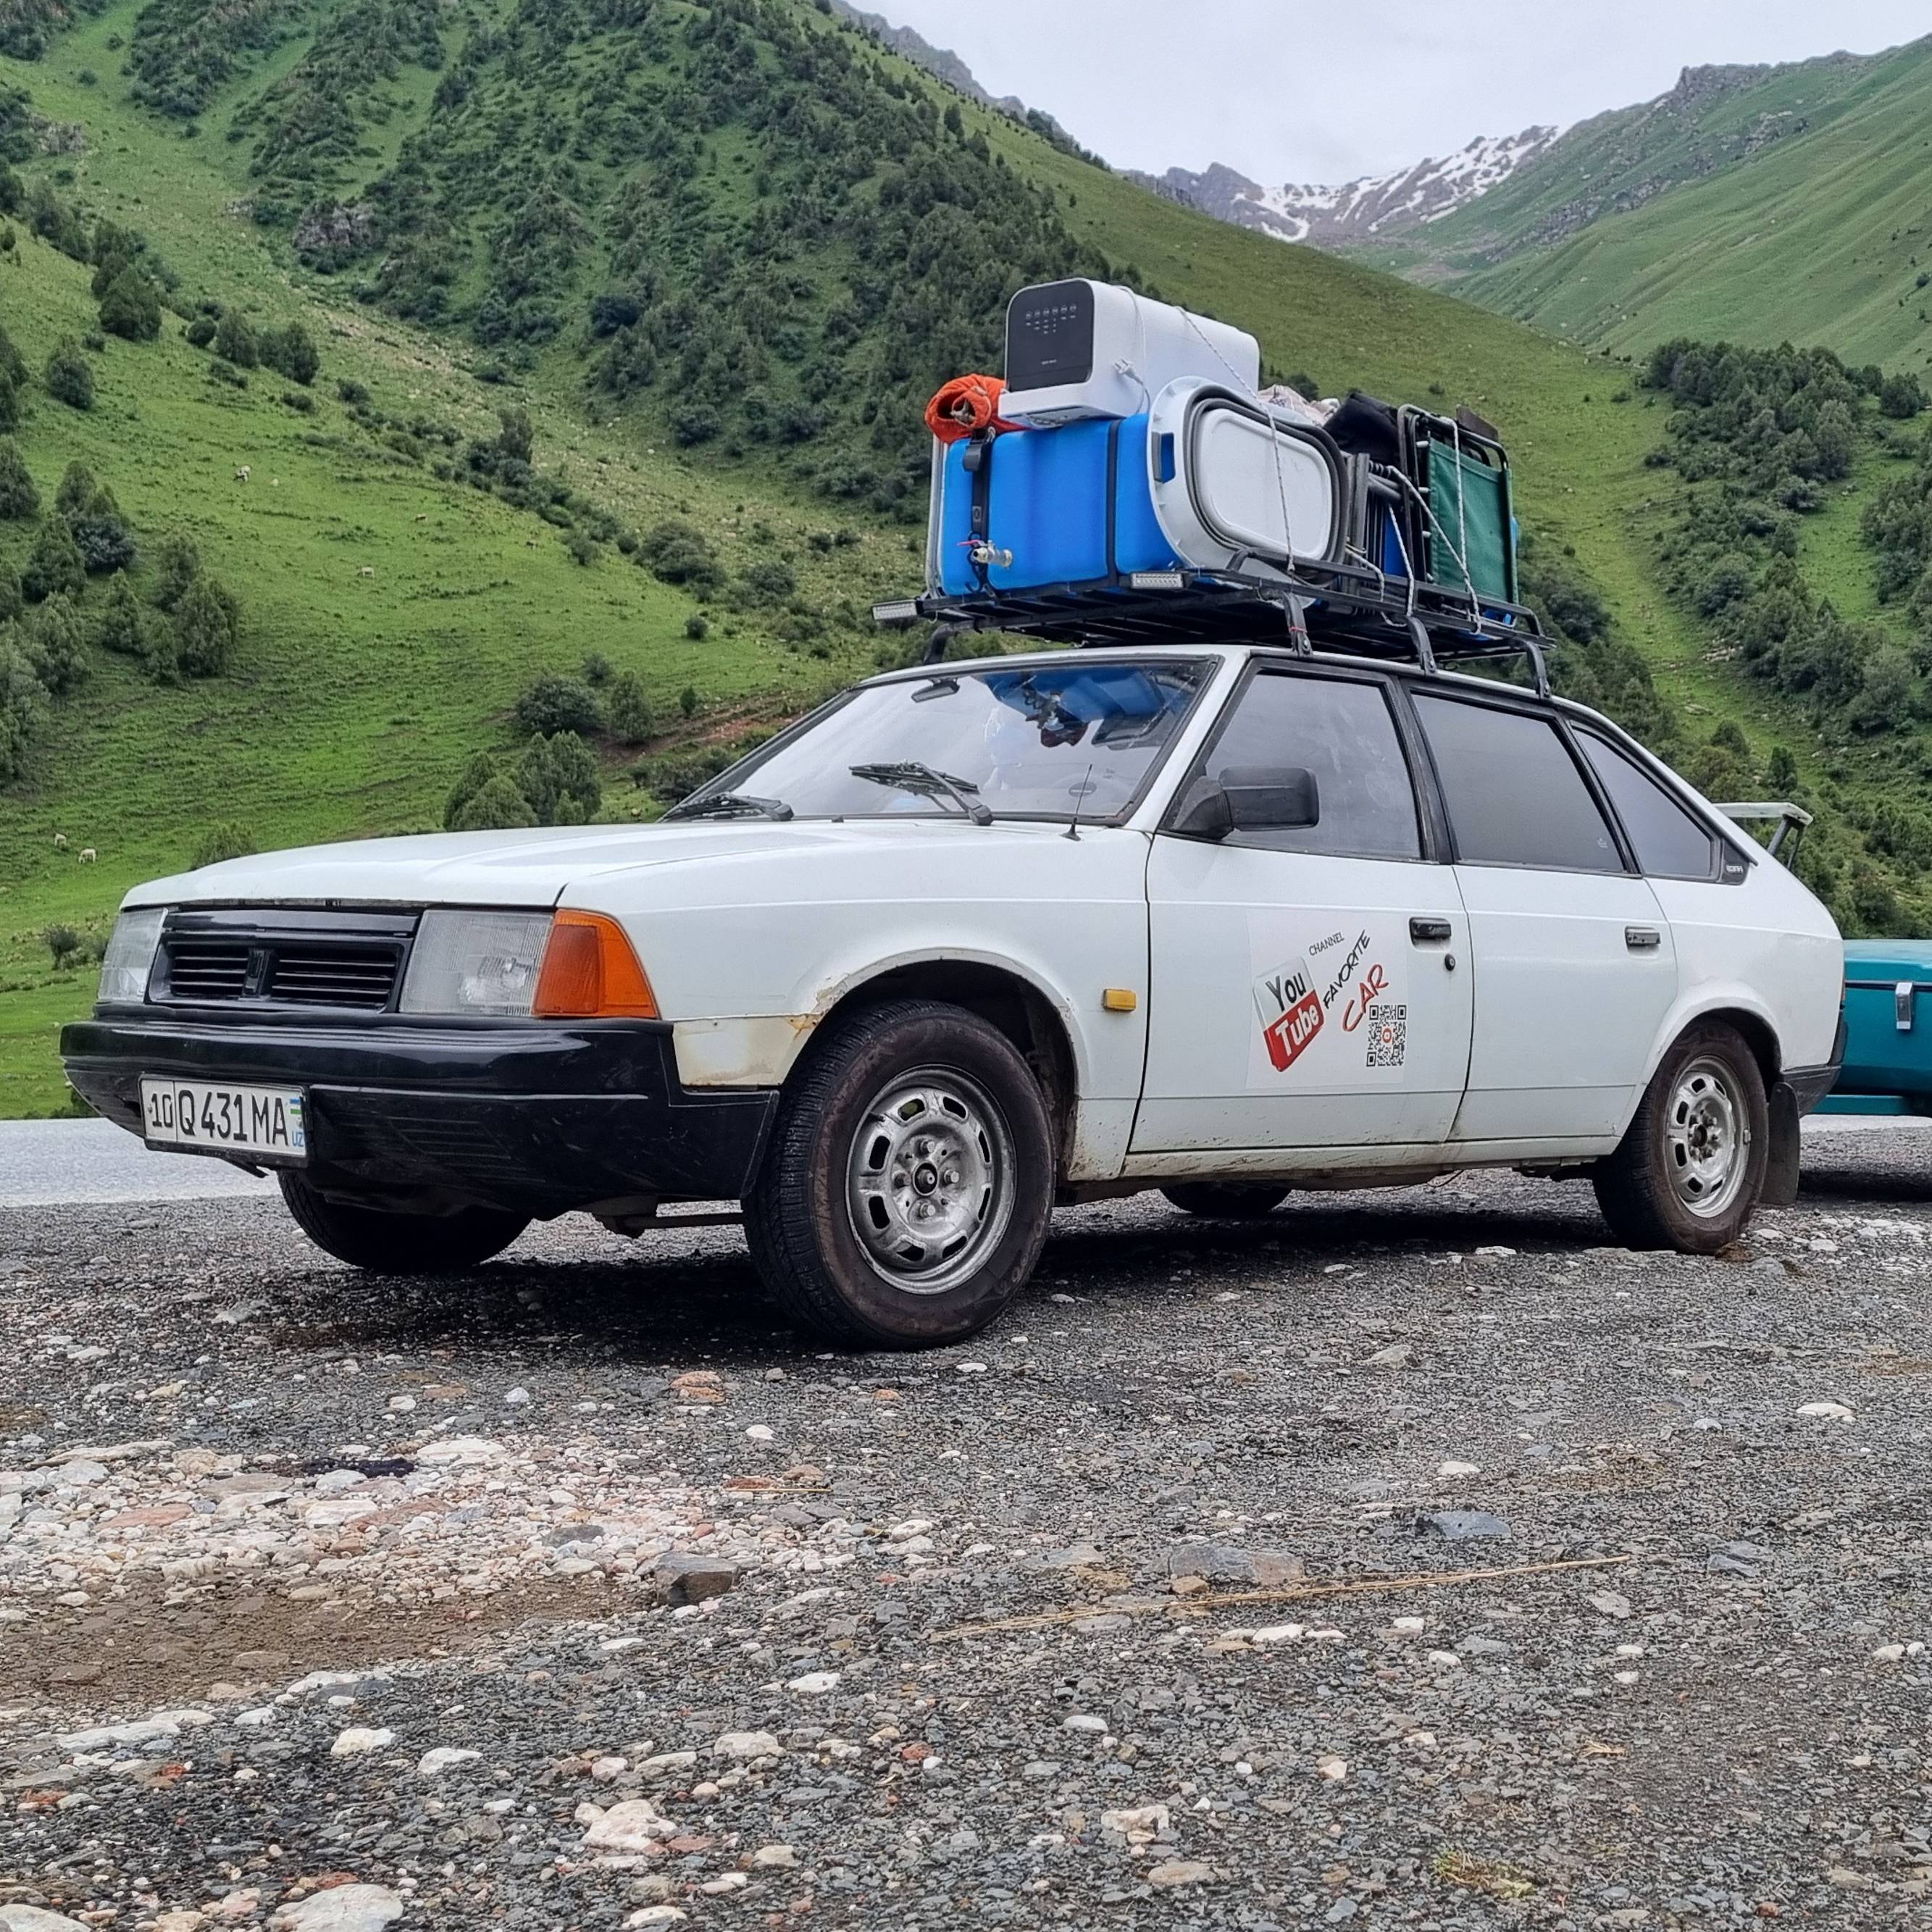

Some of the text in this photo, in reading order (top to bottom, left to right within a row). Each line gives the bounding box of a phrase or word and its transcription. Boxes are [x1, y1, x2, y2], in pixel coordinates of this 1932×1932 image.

[1308, 932, 1345, 956] CHANNEL
[1266, 972, 1307, 1012] You
[1323, 930, 1370, 1009] FAVORITE
[1342, 964, 1389, 1032] CAR
[1275, 1004, 1319, 1056] Tube
[291, 1130, 304, 1147] UZ
